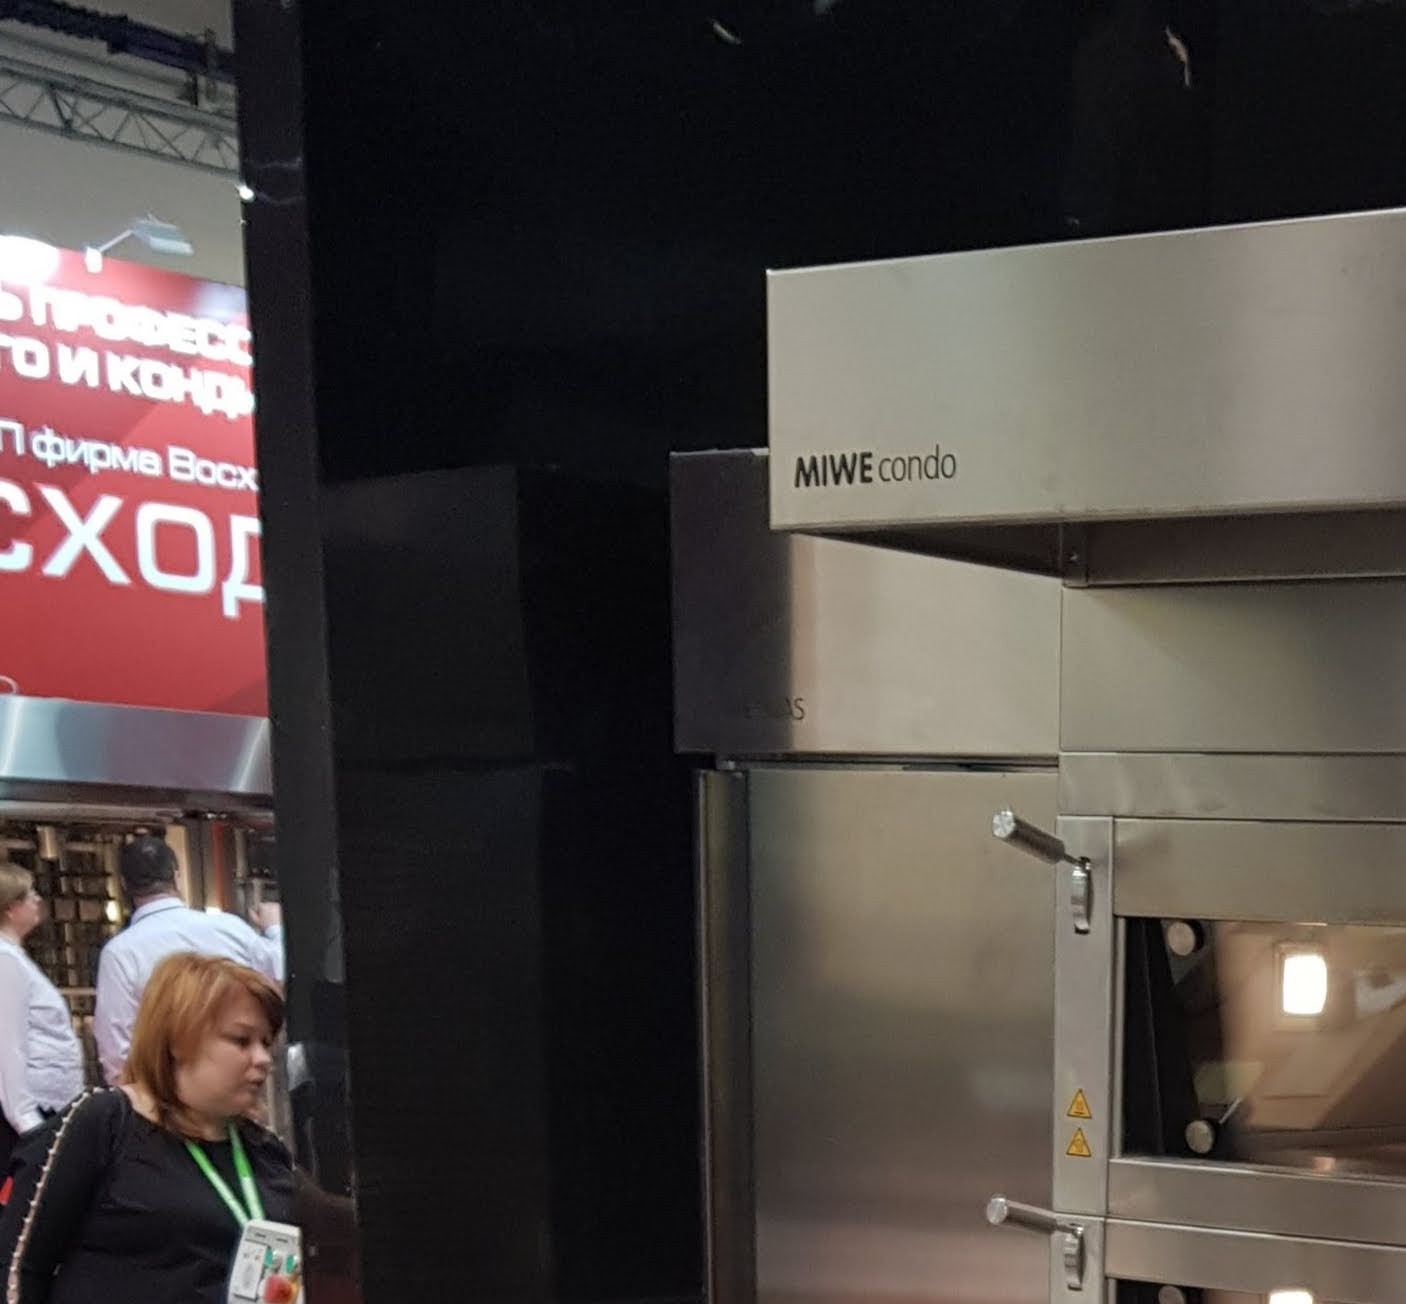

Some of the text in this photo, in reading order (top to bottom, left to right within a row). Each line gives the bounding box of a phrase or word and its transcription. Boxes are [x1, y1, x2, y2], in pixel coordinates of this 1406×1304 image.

[0, 331, 50, 380] О
[56, 342, 100, 388] И
[30, 424, 164, 475] фирма
[794, 443, 957, 488] MIWE condo
